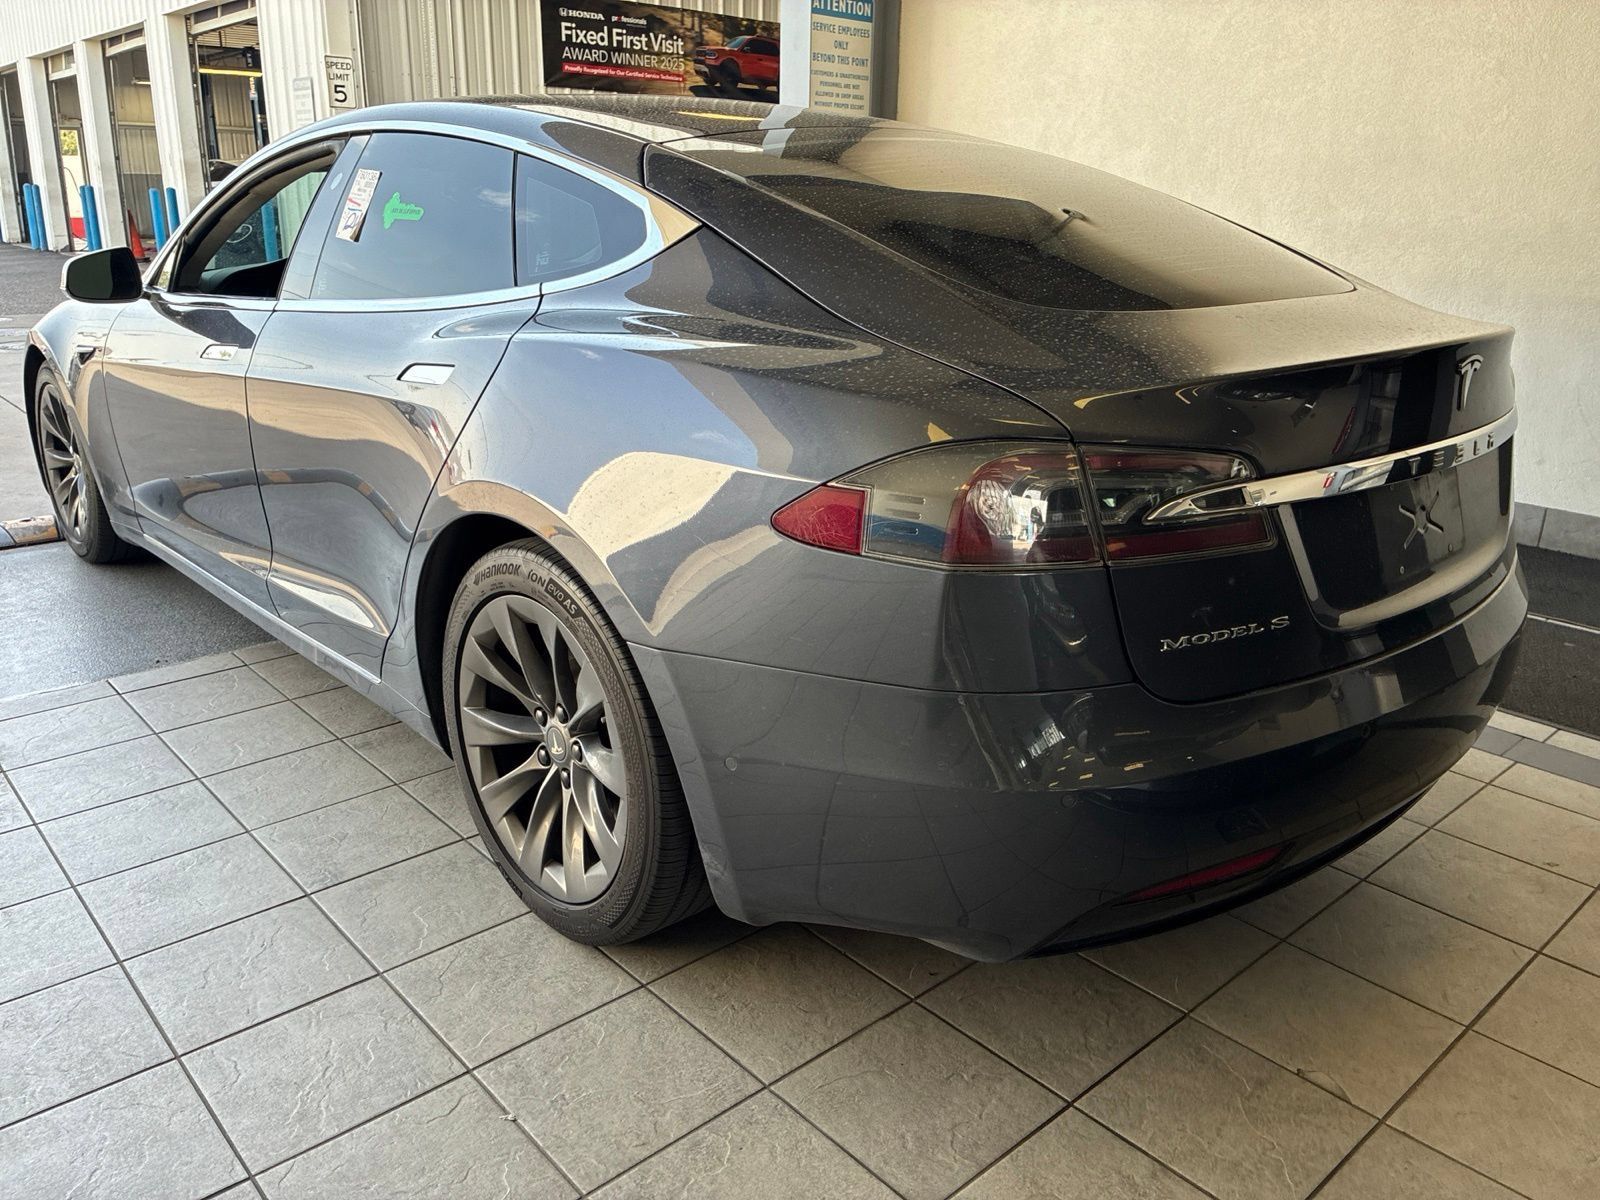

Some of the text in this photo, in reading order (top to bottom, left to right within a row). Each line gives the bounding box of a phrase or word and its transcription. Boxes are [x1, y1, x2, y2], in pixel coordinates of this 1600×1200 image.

[568, 9, 605, 20] HONDA
[812, 0, 872, 17] ATTENTION
[561, 21, 684, 55] Fixed First Visit
[812, 21, 870, 38] SERVICE EMPLOYEES
[834, 40, 849, 50] ONLY
[326, 61, 352, 71] SPEED
[562, 46, 685, 71] AWARD WINNER 2025
[812, 52, 869, 68] BEYOND THIS POINT
[328, 72, 350, 82] LIMIT
[334, 84, 348, 103] 5
[1408, 432, 1495, 476] TESLA
[547, 583, 565, 601] evo
[563, 599, 578, 615] AS
[1160, 615, 1291, 652] MODEL S
